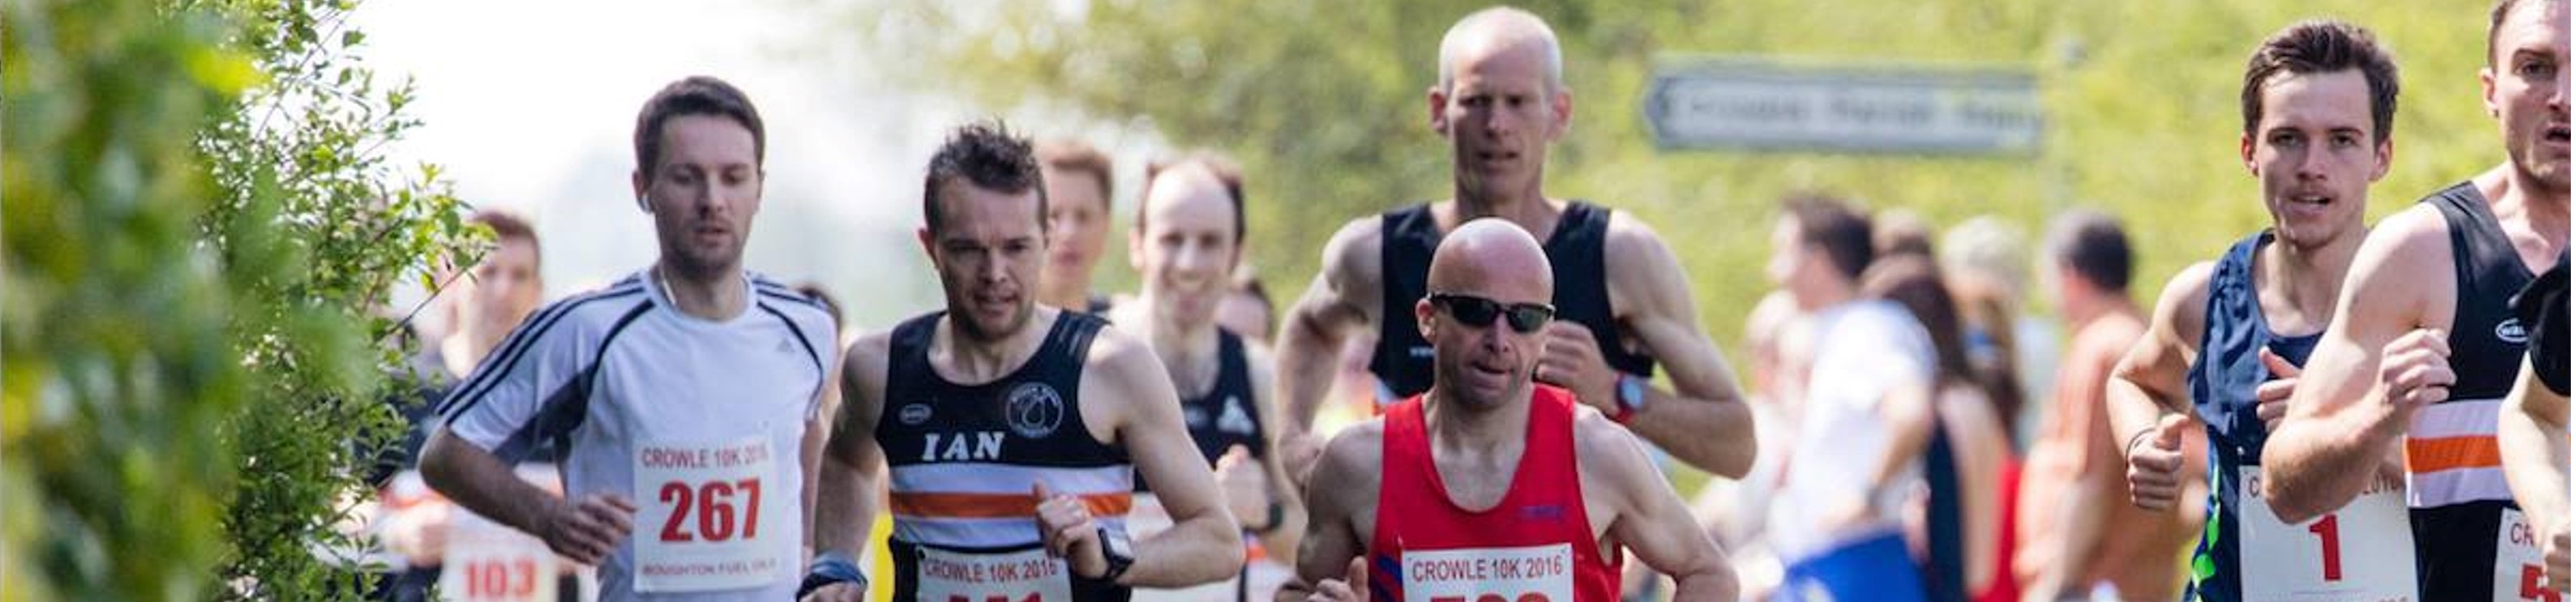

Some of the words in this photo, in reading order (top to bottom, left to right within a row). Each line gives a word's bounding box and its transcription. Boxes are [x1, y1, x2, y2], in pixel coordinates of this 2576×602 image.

[641, 447, 708, 469] CROWLE
[714, 446, 742, 468] 10K
[921, 431, 1005, 461] IAN
[660, 478, 759, 541] 267
[2309, 514, 2342, 581] 1
[464, 558, 537, 600] 103
[924, 559, 985, 583] CROWLE
[990, 561, 1019, 583] 10K
[1023, 558, 1059, 579] 2016
[1412, 559, 1486, 582] CROWLE
[1492, 557, 1520, 579] 10K
[1525, 555, 1563, 578] 2016
